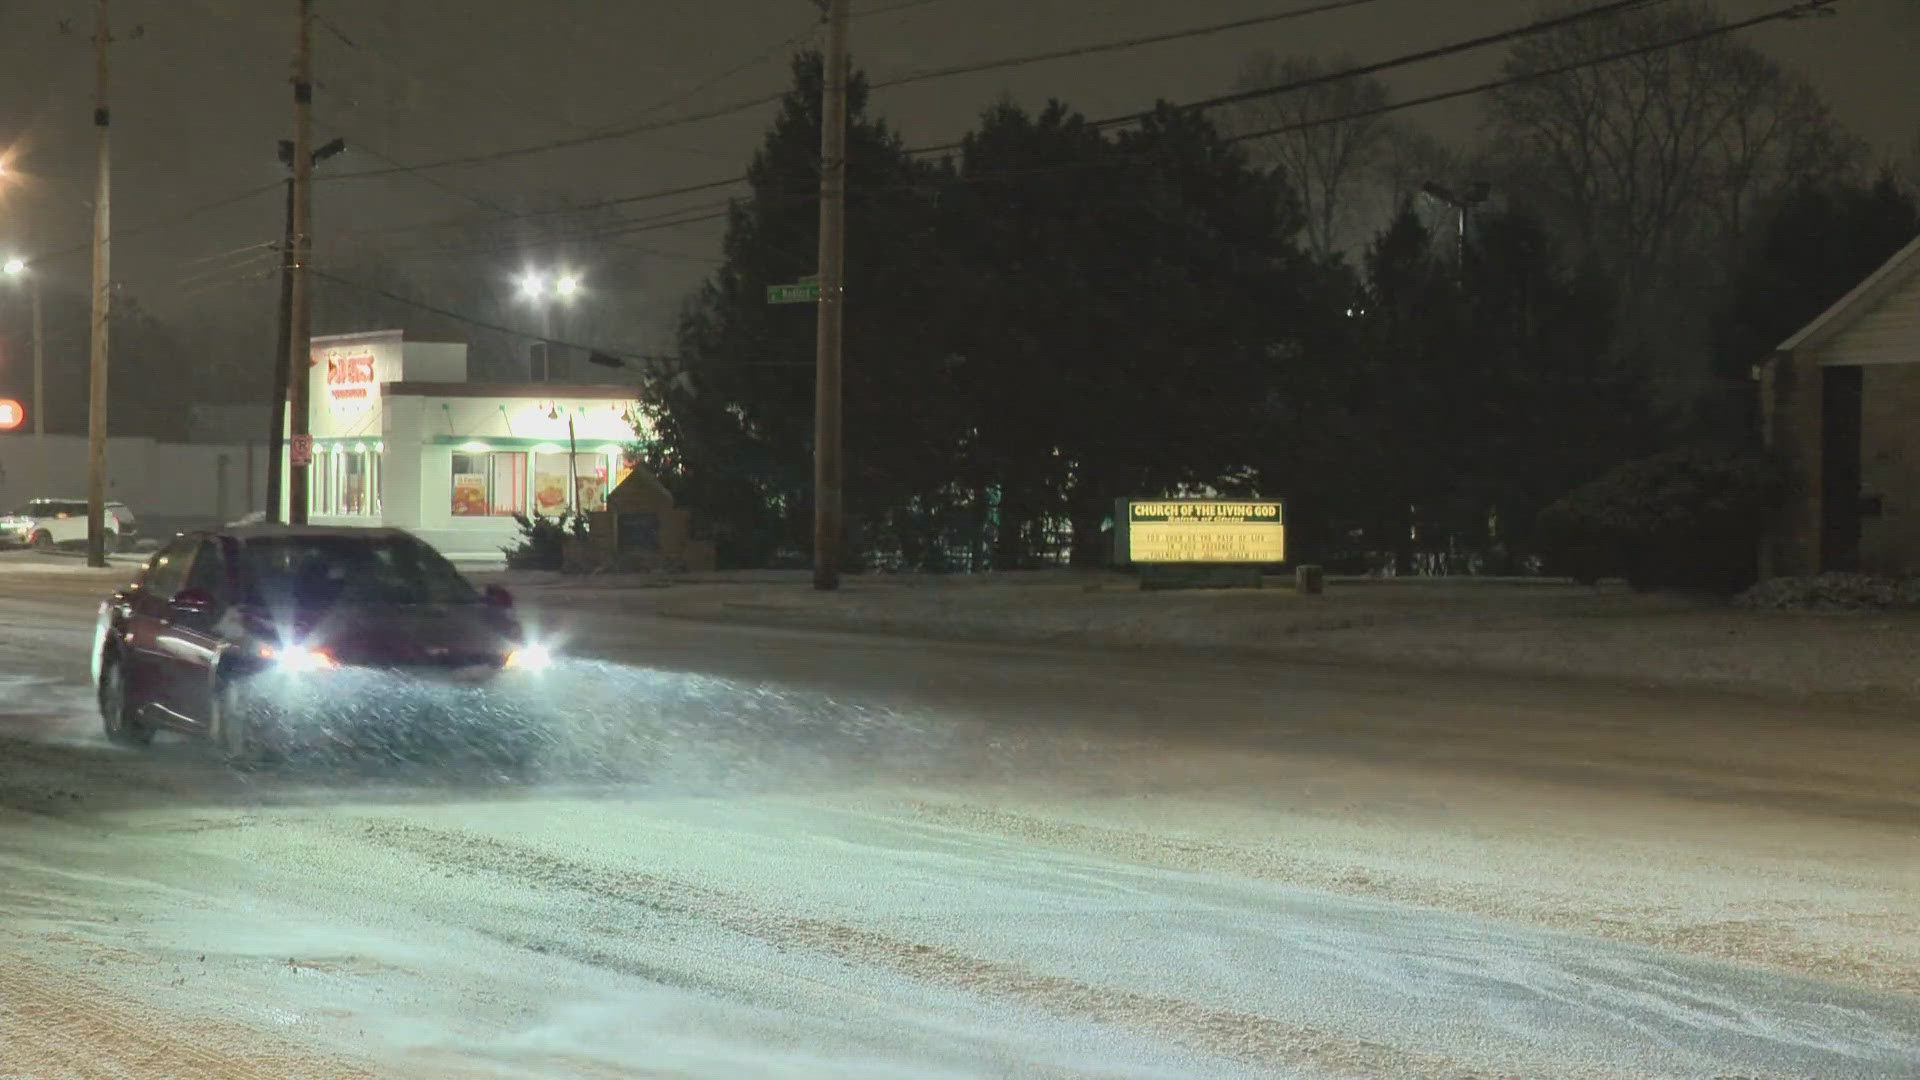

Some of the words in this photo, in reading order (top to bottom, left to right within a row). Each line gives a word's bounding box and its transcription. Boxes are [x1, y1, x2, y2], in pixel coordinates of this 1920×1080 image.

[1134, 505, 1178, 516] CHURCH
[1180, 505, 1193, 516] OF
[1195, 505, 1216, 516] THE
[1217, 505, 1252, 517] LIVING
[1254, 505, 1276, 517] GOD
